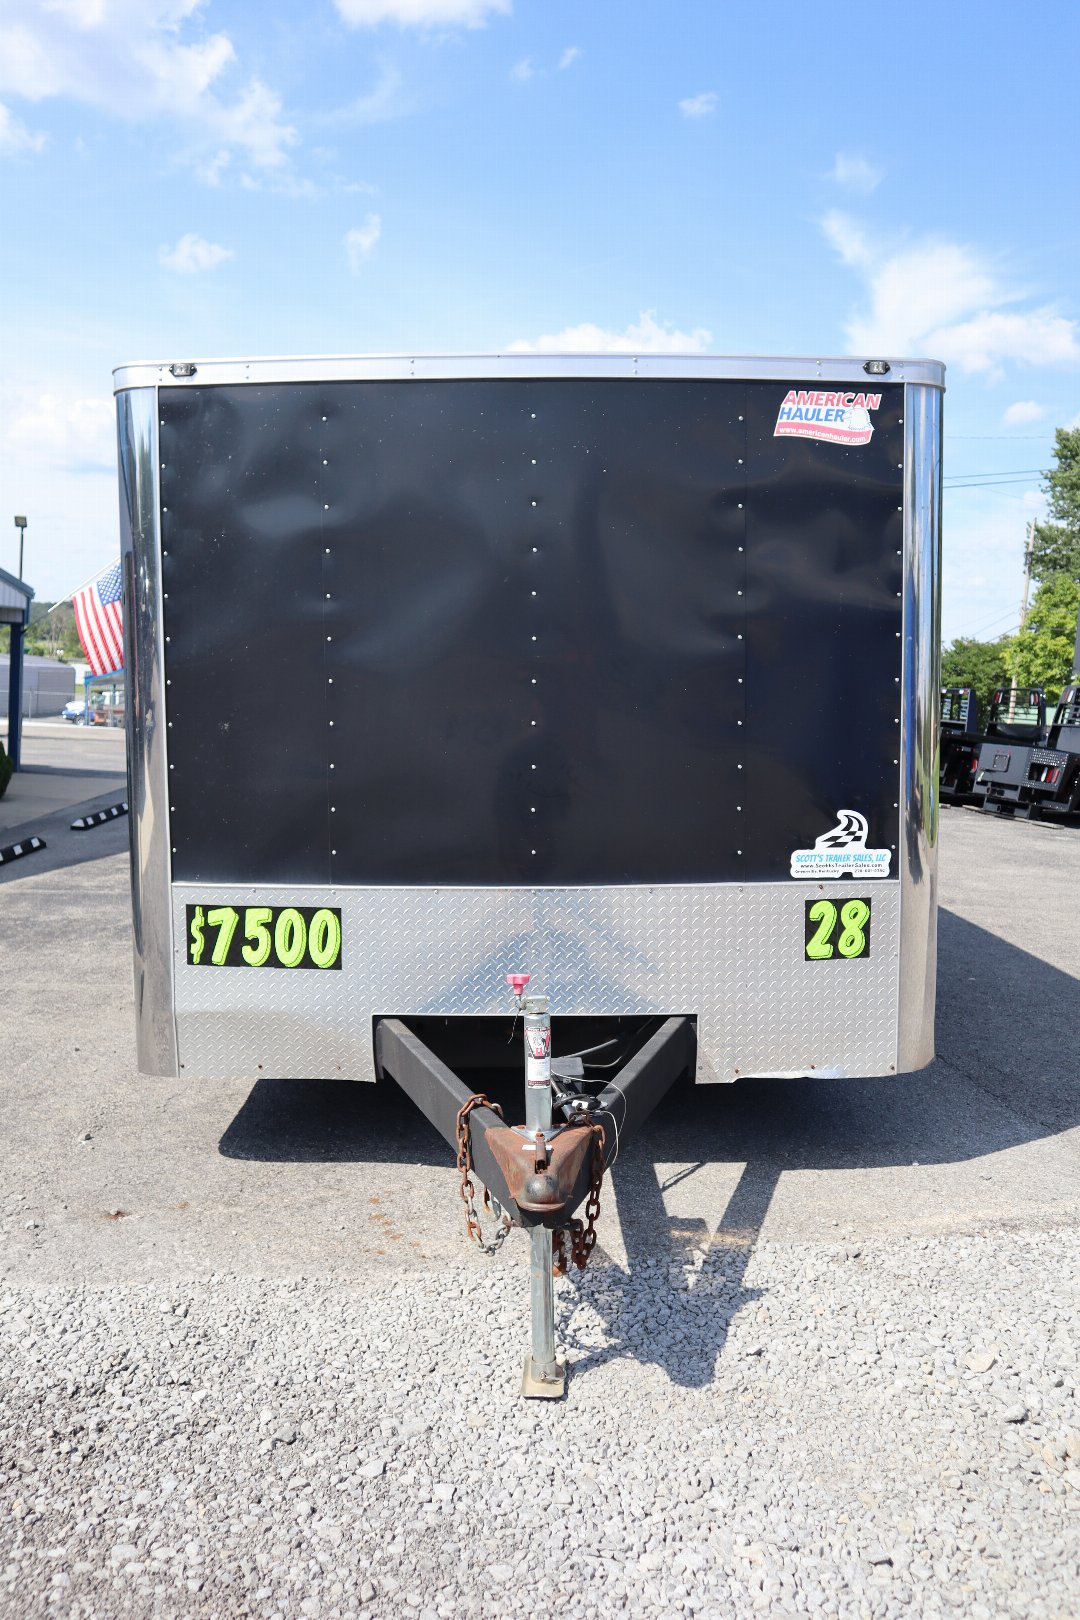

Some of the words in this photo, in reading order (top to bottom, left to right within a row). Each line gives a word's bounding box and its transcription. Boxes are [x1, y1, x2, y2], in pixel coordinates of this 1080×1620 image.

[782, 391, 881, 409] AMERICAN
[779, 407, 845, 422] HAULER
[779, 427, 866, 443] www.americanhauler.com
[795, 854, 824, 863] SCOTT'S
[825, 854, 851, 863] TRAILER
[853, 853, 874, 863] SALES,
[875, 853, 887, 862] LLC
[190, 905, 341, 969] $7500
[806, 899, 870, 960] 28
